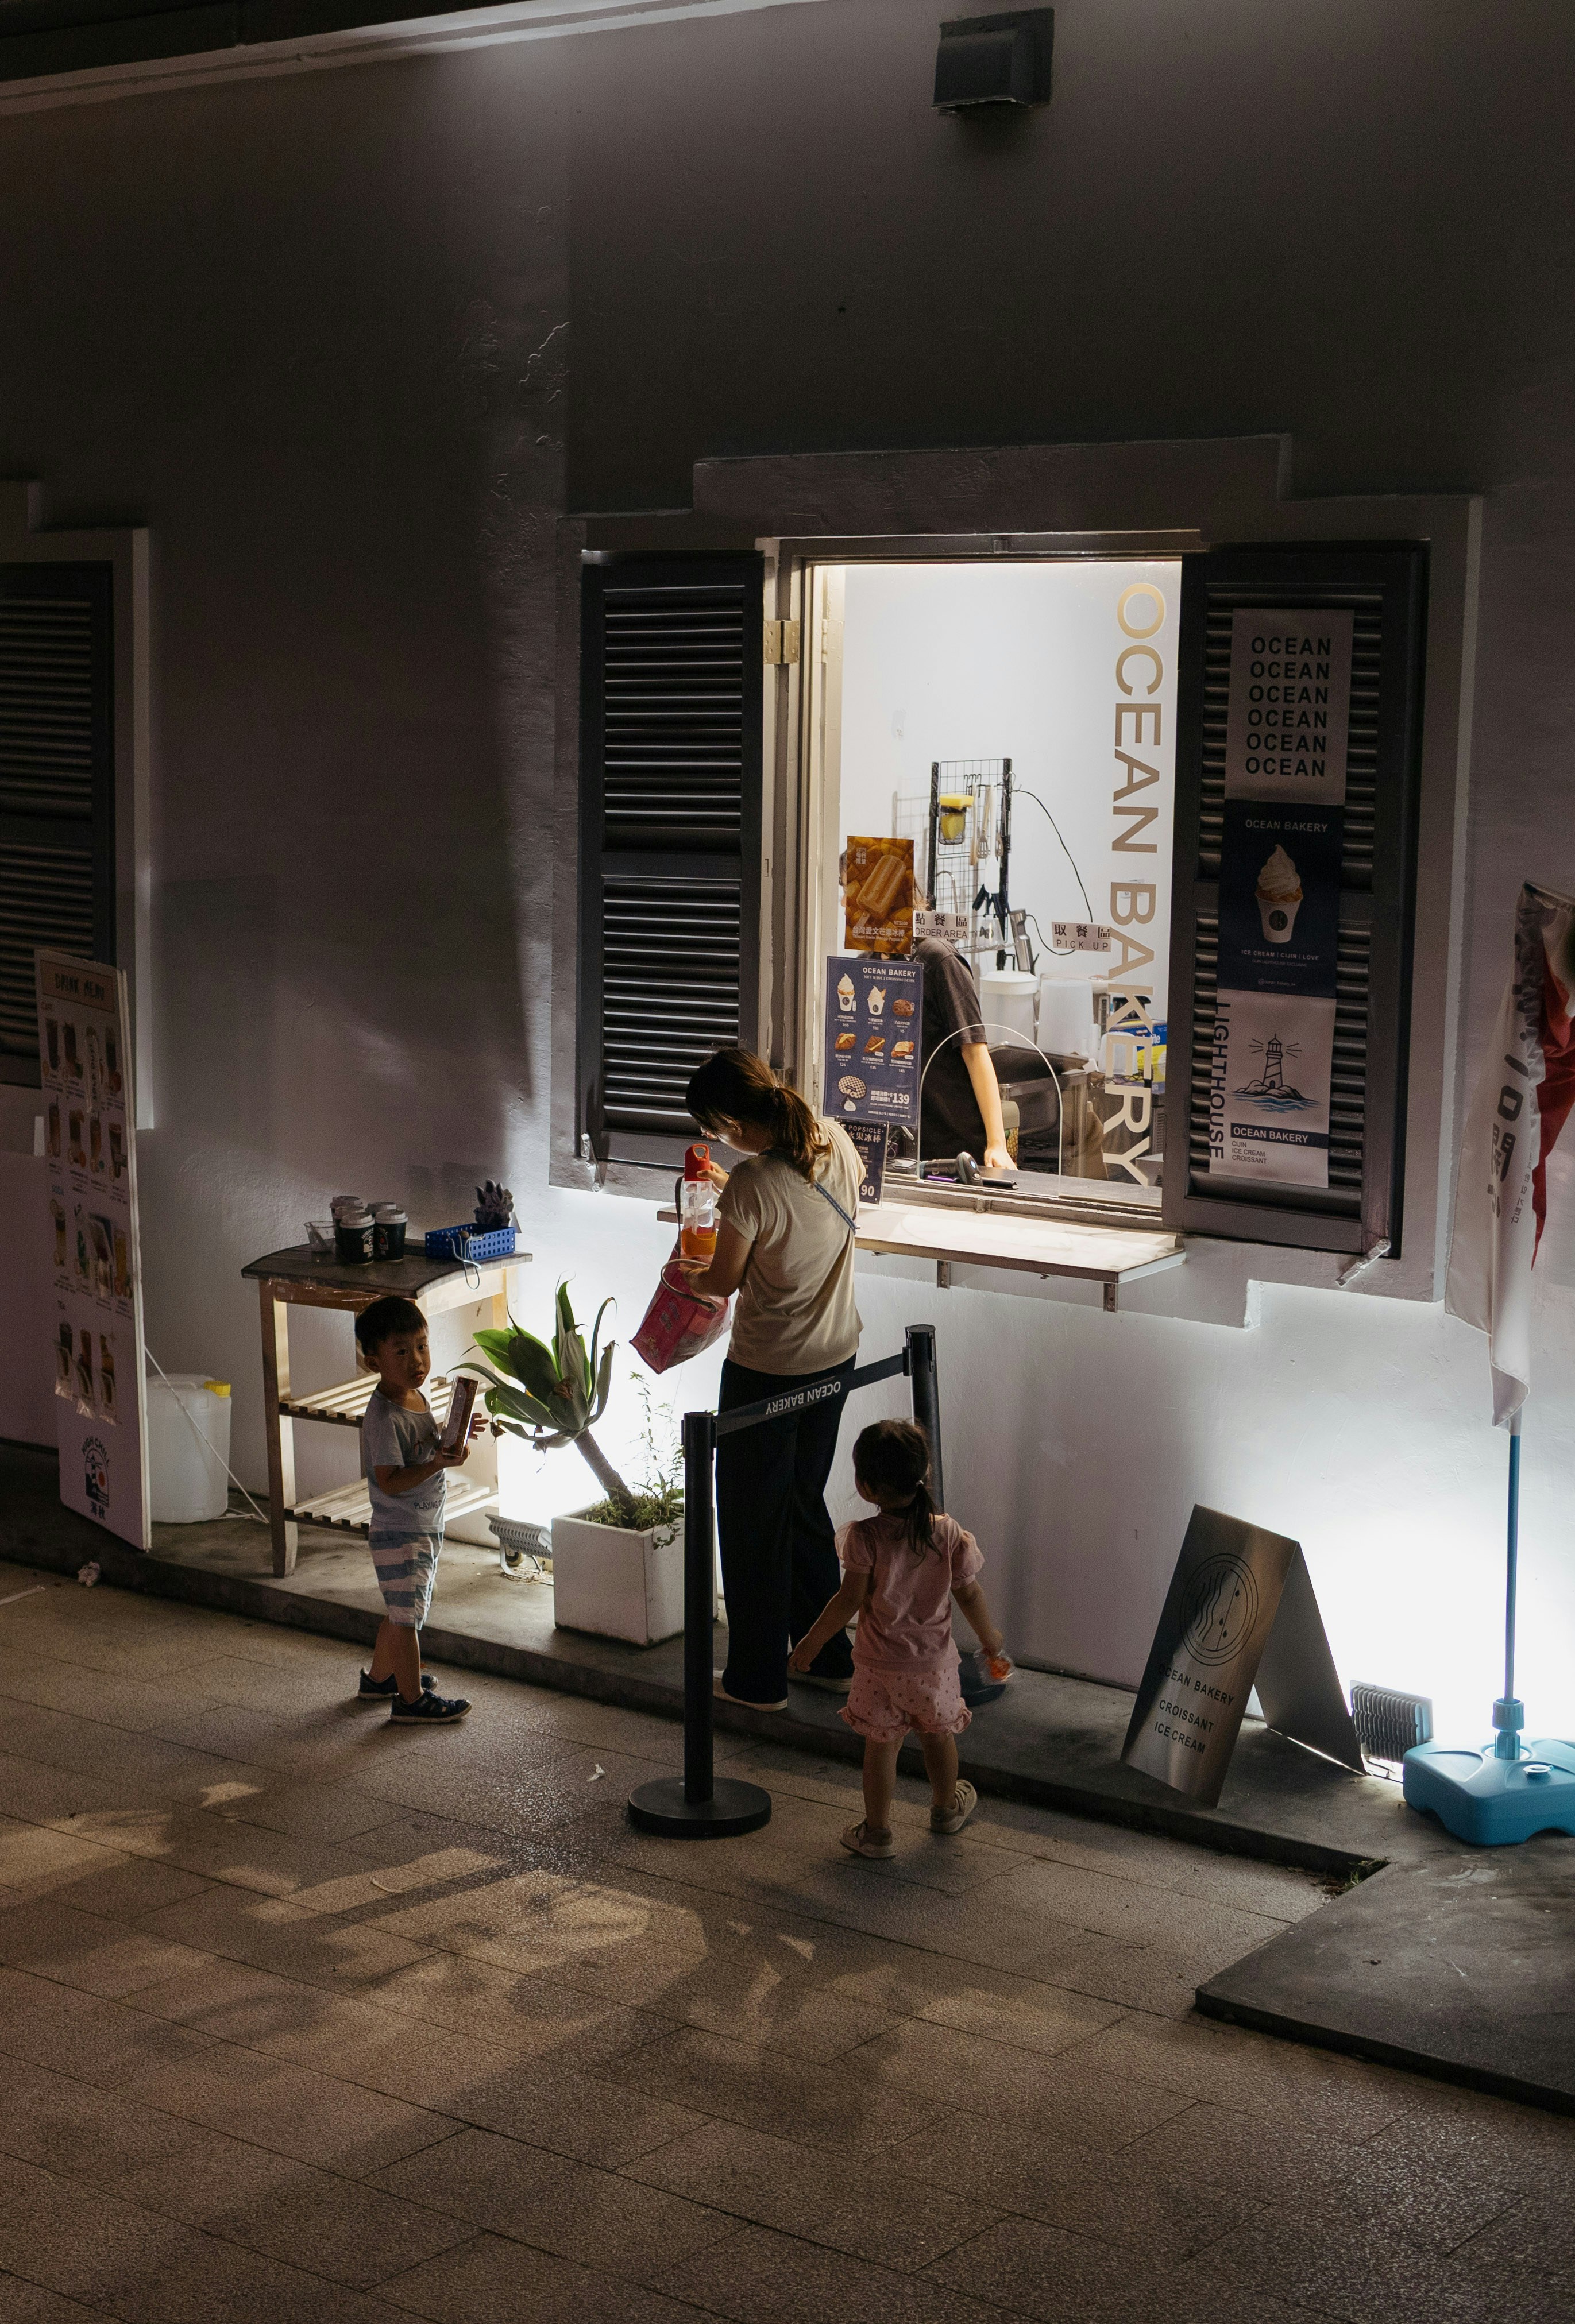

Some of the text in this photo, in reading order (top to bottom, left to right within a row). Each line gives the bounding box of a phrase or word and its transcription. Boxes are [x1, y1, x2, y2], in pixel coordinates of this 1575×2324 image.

[1250, 636, 1331, 656] OCEAN
[1249, 660, 1330, 680] OCEAN
[1248, 685, 1329, 704] OCEAN
[1247, 709, 1328, 729] OCEAN
[1246, 733, 1327, 753] OCEAN
[1245, 757, 1326, 777] OCEAN
[1245, 819, 1328, 833] OCEAN BAKERY
[1102, 582, 1166, 1189] OCEAN BAKERY
[915, 912, 968, 928] 點餐區
[915, 927, 968, 938] ORDER AREA
[1054, 923, 1110, 939] 取餐區
[1056, 939, 1109, 950] PICK UP
[862, 967, 916, 977] OCEAN BAKERY
[1209, 1002, 1231, 1159] LIGHTHOUSE
[848, 1124, 882, 1134] POPSICLE
[848, 1131, 882, 1143] 水果冰棒
[1233, 1126, 1309, 1144] OCEAN BAKERY
[1232, 1155, 1267, 1165] CROISSANT
[1243, 1149, 1266, 1157] CREAM
[765, 1381, 841, 1415] OCEAN BAKERY
[1158, 1664, 1234, 1706] OCEAN BAKERY
[1159, 1699, 1214, 1733] CROISSANT
[1154, 1721, 1206, 1754] ICE CREAM
